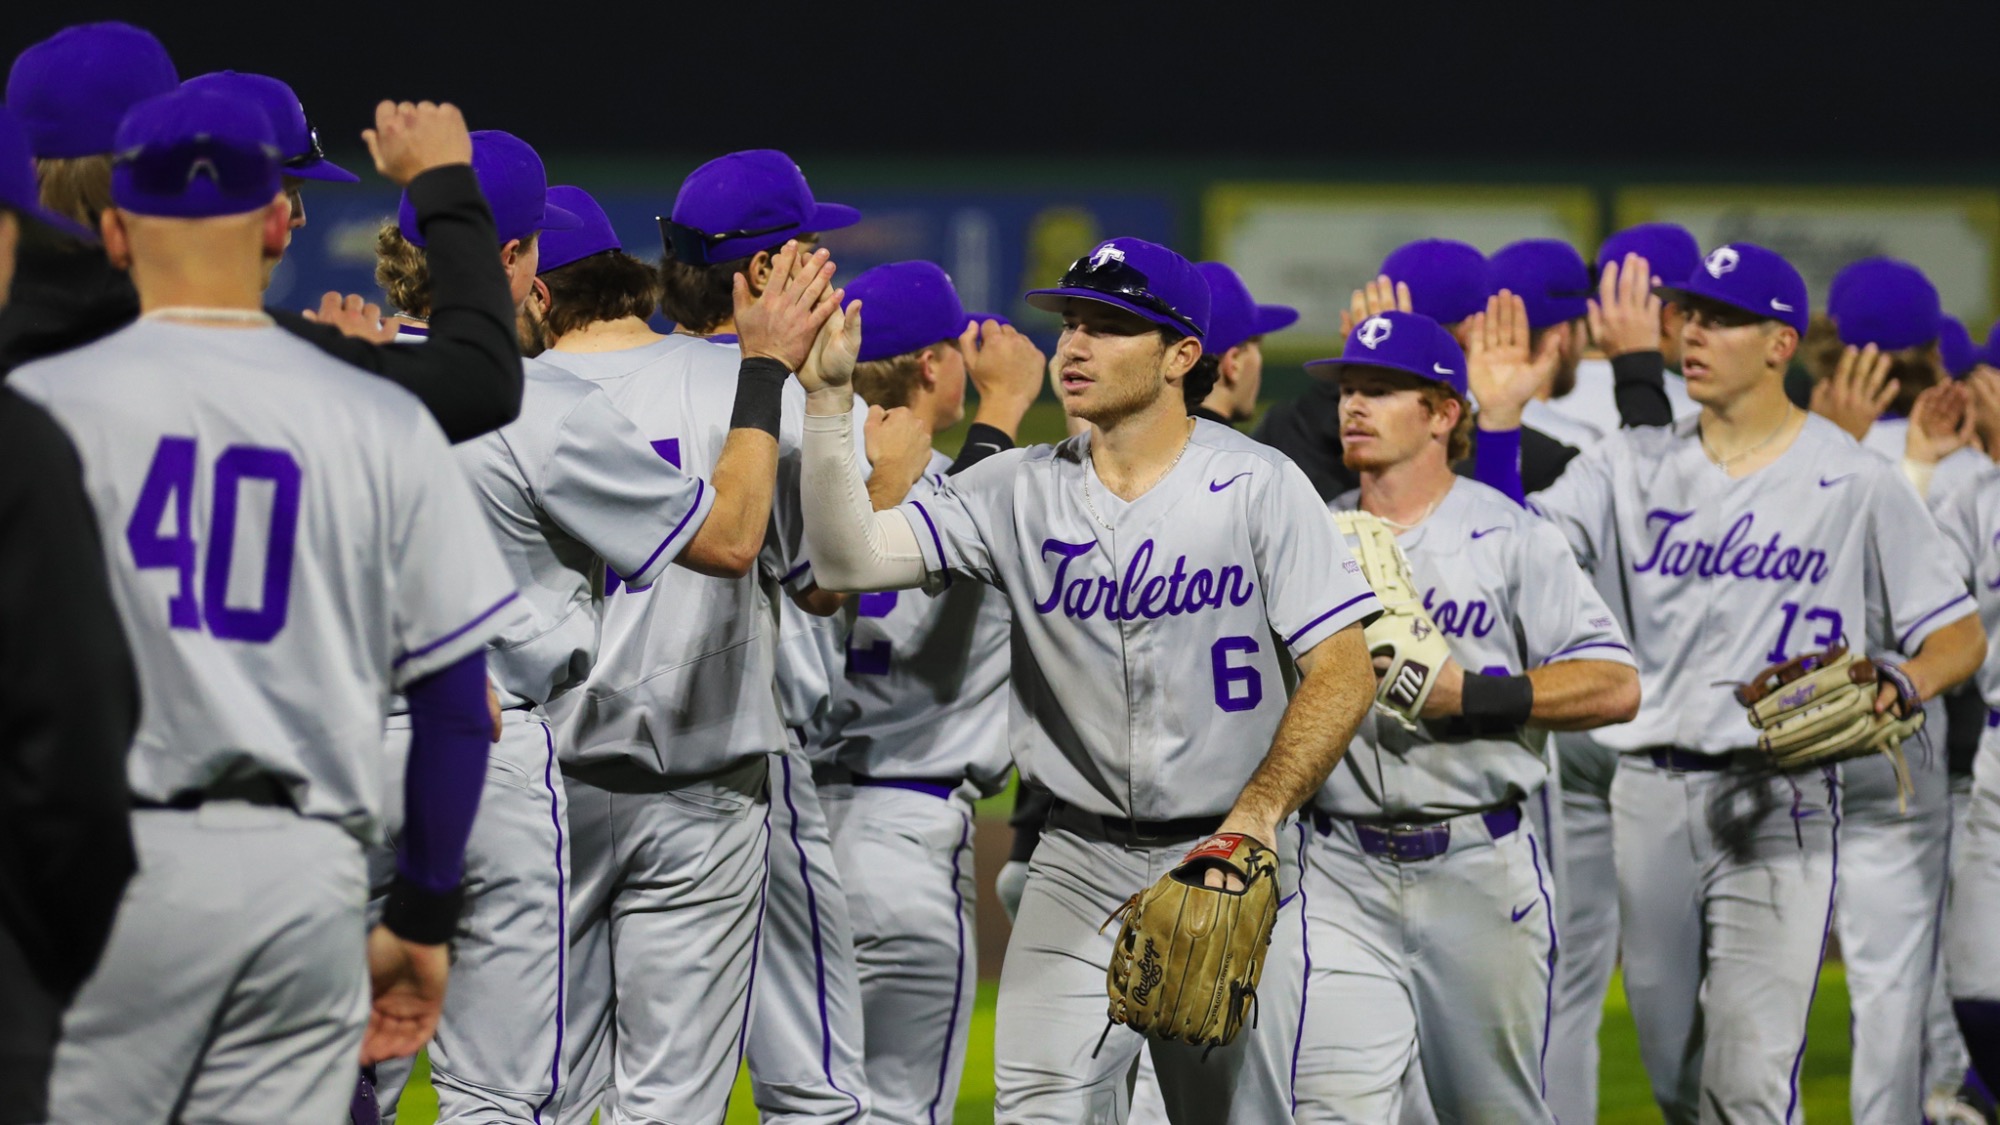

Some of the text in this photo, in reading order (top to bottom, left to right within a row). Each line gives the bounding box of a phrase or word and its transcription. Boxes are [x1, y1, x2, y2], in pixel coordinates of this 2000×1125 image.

[126, 434, 302, 644] 40
[1633, 507, 1829, 584] Tarleton
[1034, 538, 1254, 621] Tarleton
[1766, 601, 1843, 670] 13
[1211, 636, 1263, 712] 6
[1132, 937, 1162, 1006] Rawlings
